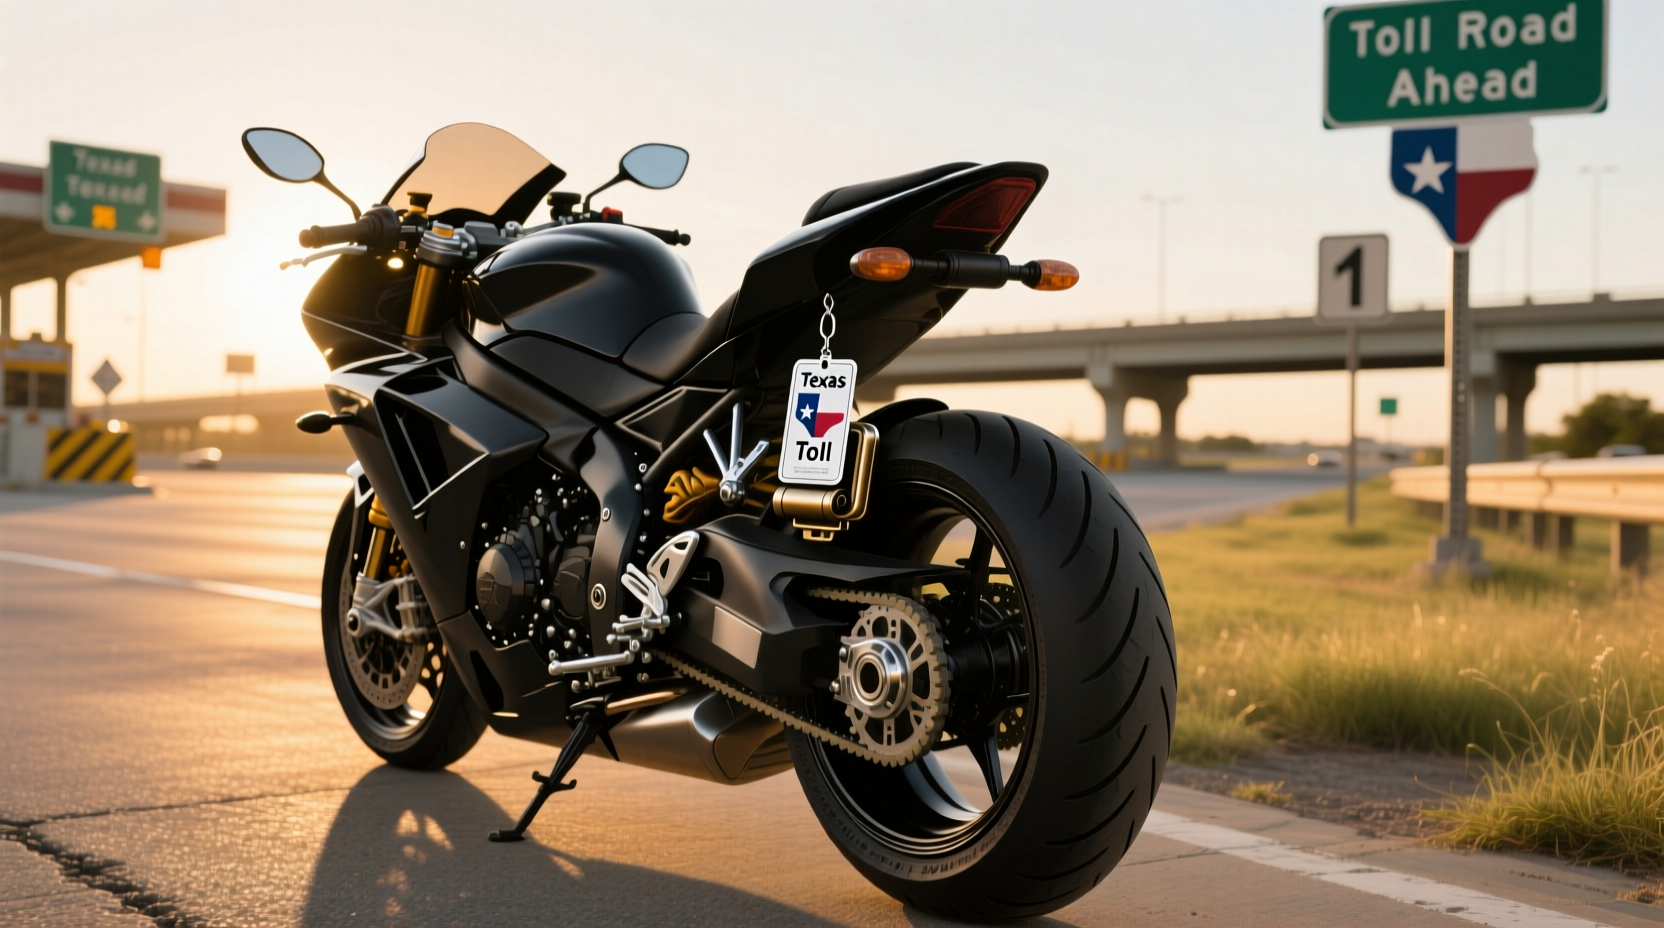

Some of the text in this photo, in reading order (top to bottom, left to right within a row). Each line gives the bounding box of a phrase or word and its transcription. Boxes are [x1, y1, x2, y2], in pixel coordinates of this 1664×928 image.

[1349, 2, 1577, 58] Toll Road
[1386, 59, 1537, 108] Ahead
[1334, 245, 1363, 307] 1
[801, 372, 847, 388] Texas
[796, 441, 832, 462] Toll
